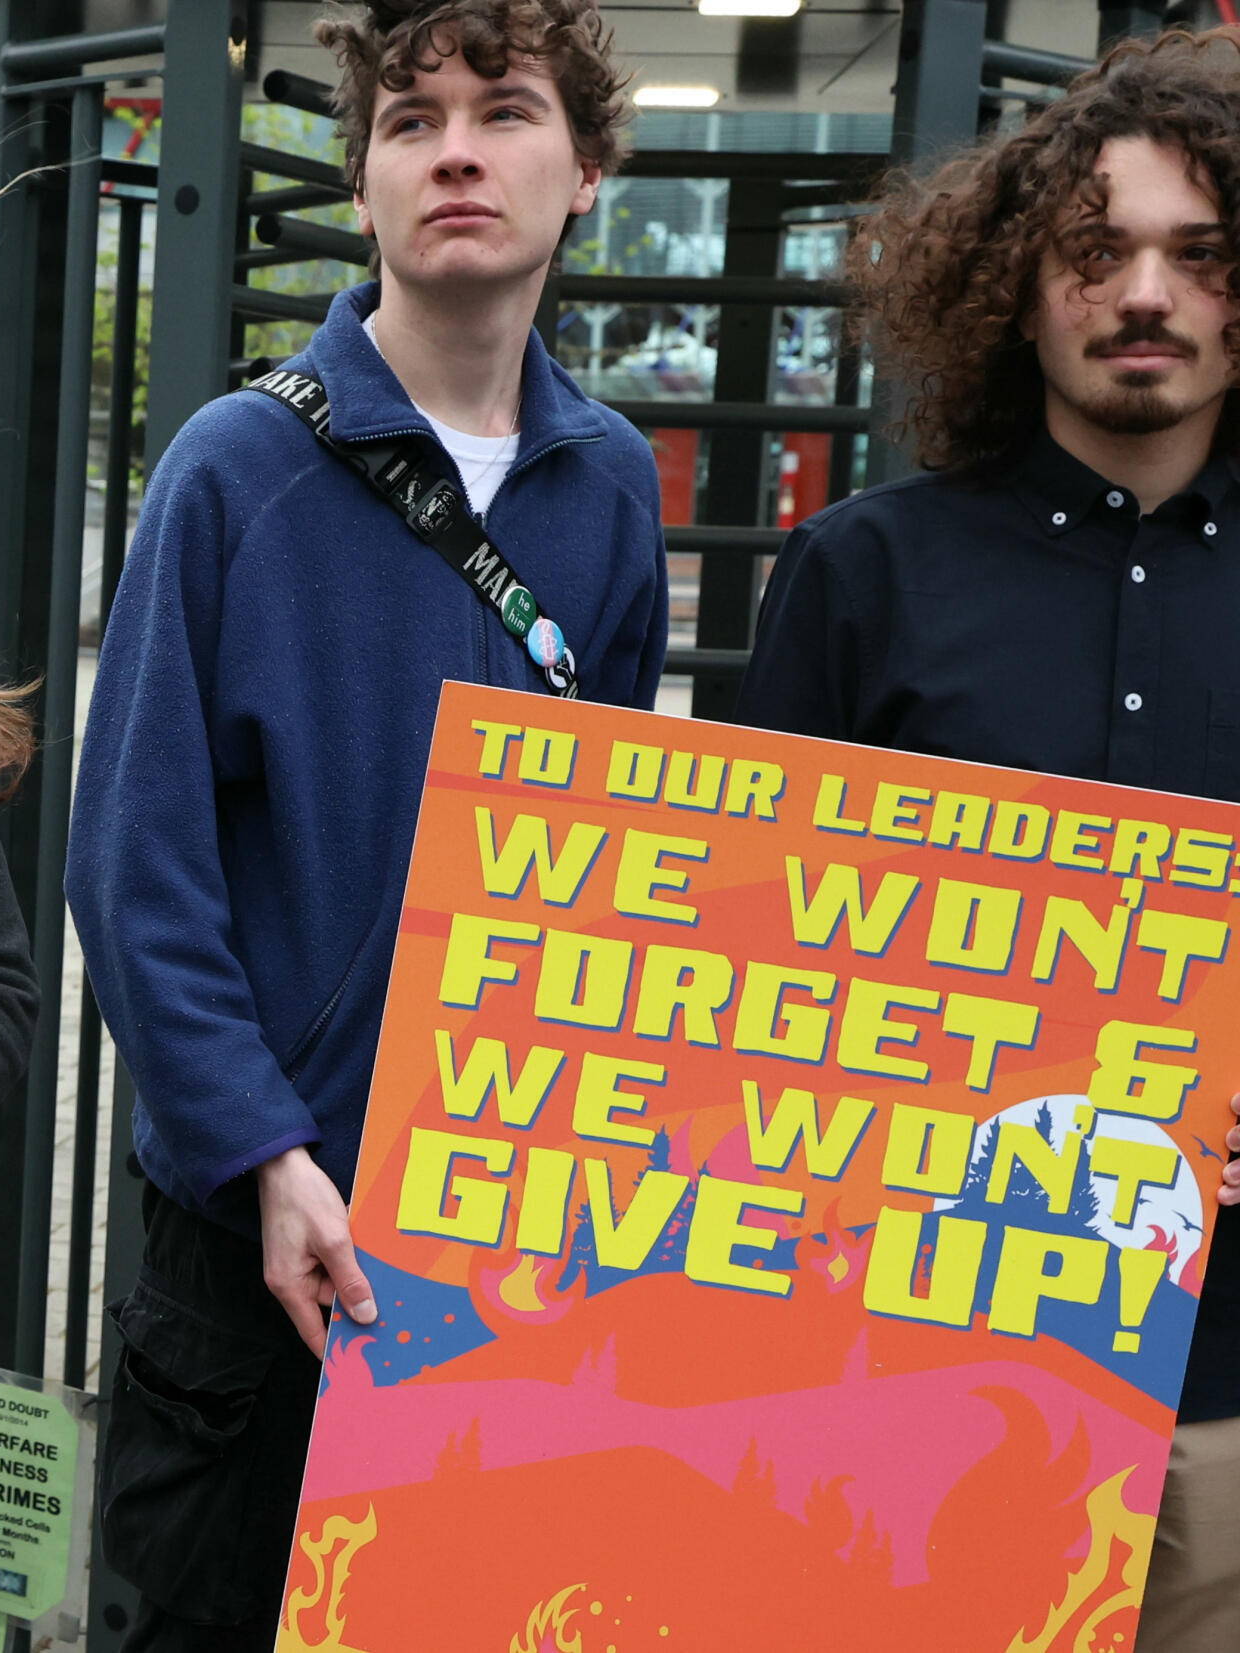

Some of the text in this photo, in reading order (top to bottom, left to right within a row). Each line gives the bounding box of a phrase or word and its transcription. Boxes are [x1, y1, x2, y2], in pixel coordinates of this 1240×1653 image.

[508, 608, 527, 632] him
[517, 592, 530, 611] he
[472, 720, 578, 786] TO
[606, 741, 786, 819] OUR
[474, 807, 1229, 1000] WE WON'T
[439, 913, 1200, 1122] FORGET &
[435, 1030, 1180, 1228] WE WON'T
[396, 1127, 1168, 1354] GIVE UP!
[9, 1401, 50, 1419] DOUBT
